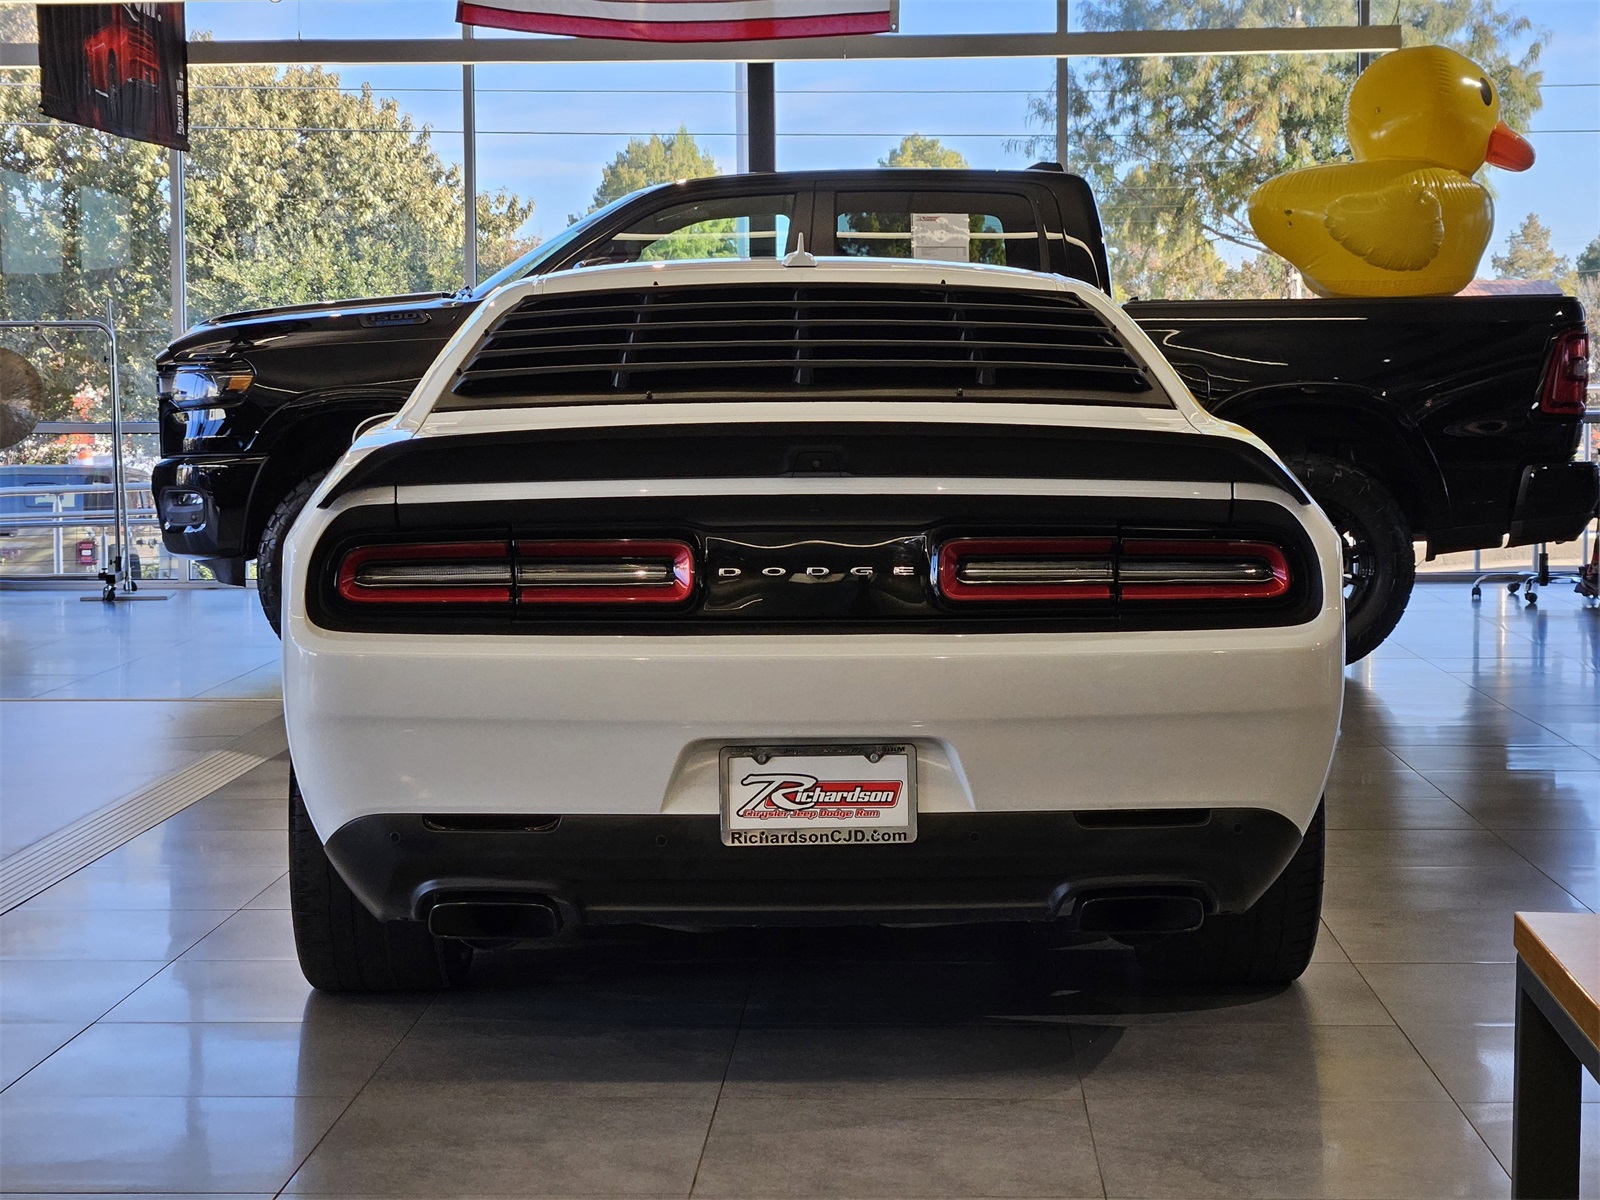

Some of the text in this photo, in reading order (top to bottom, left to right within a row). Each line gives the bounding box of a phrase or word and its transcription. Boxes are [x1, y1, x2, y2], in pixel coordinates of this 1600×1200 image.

[718, 566, 915, 577] DODGE
[736, 773, 895, 817] Richardson
[743, 809, 880, 820] Chrysler Jeep Dodge Ram
[730, 830, 908, 845] RichardsonCJD.com
